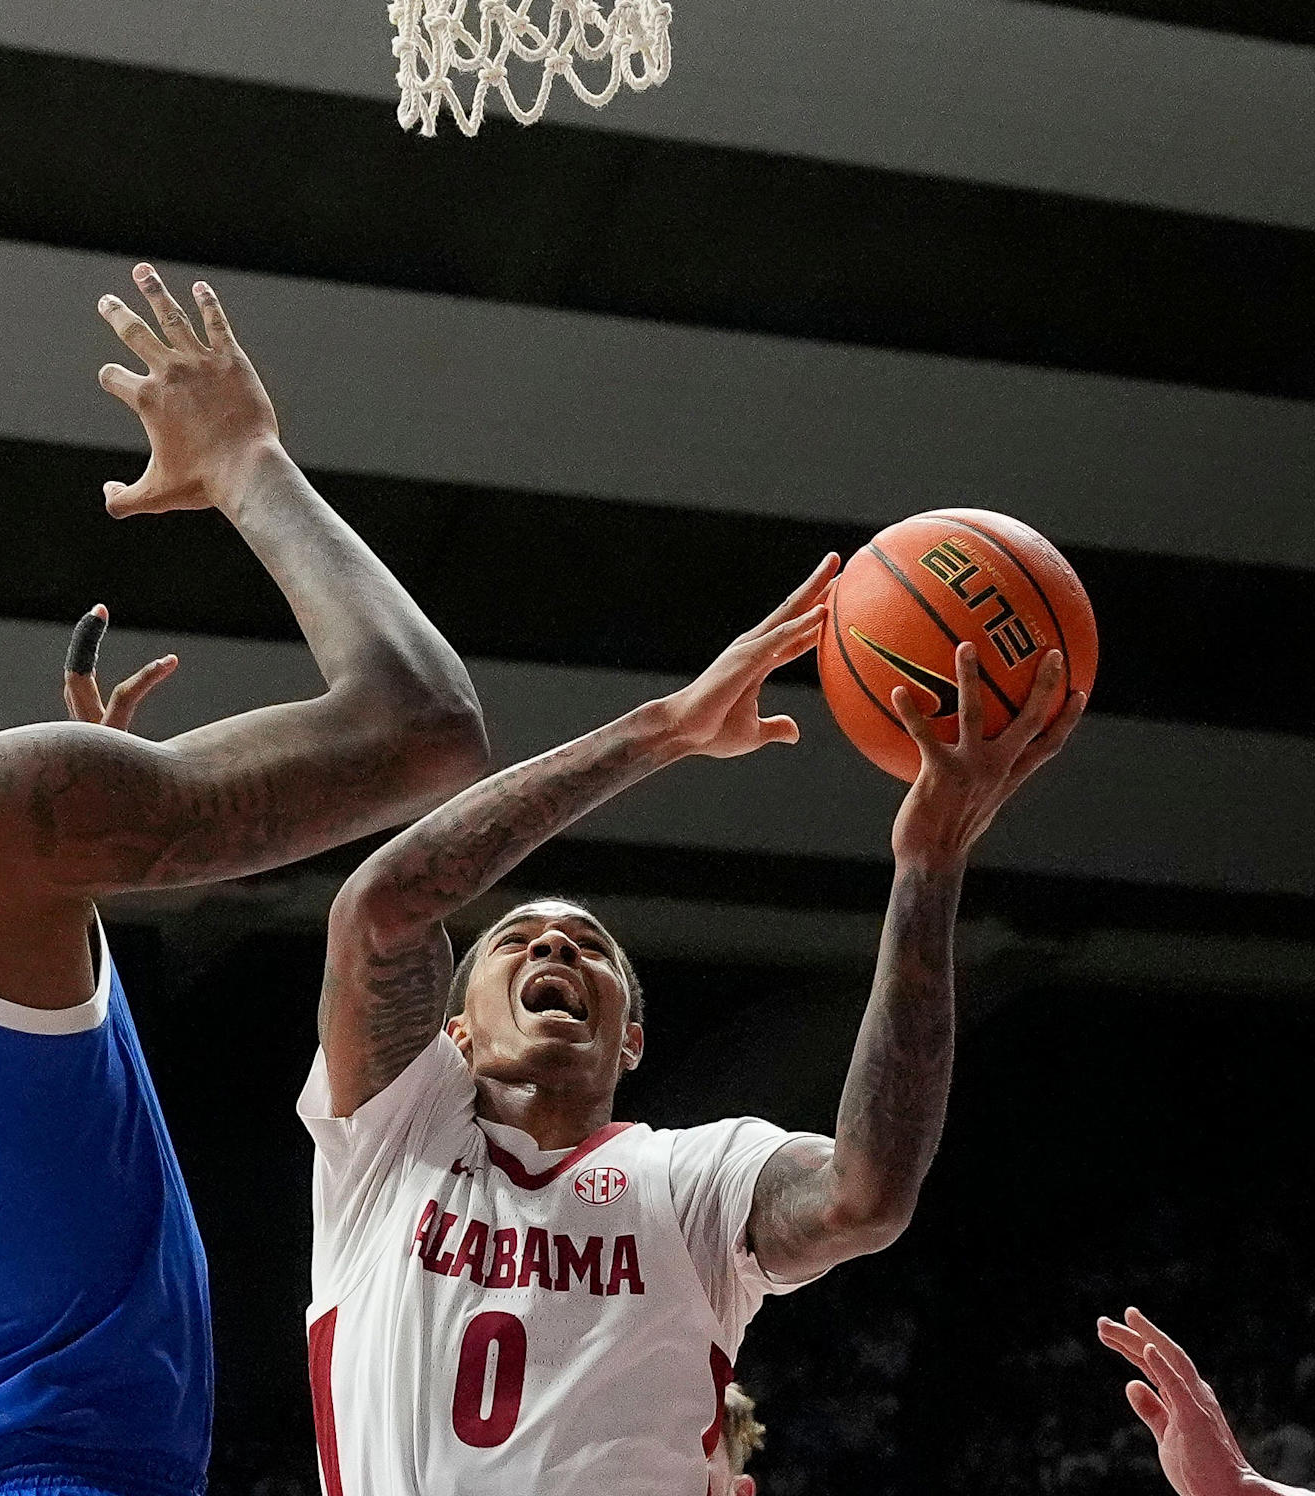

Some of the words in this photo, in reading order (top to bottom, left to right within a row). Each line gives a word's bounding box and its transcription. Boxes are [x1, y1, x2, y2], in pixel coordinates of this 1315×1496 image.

[918, 540, 1038, 671] ELITE
[575, 1168, 625, 1204] SEC
[410, 1199, 645, 1296] ALABAMA
[452, 1311, 527, 1449] 0
